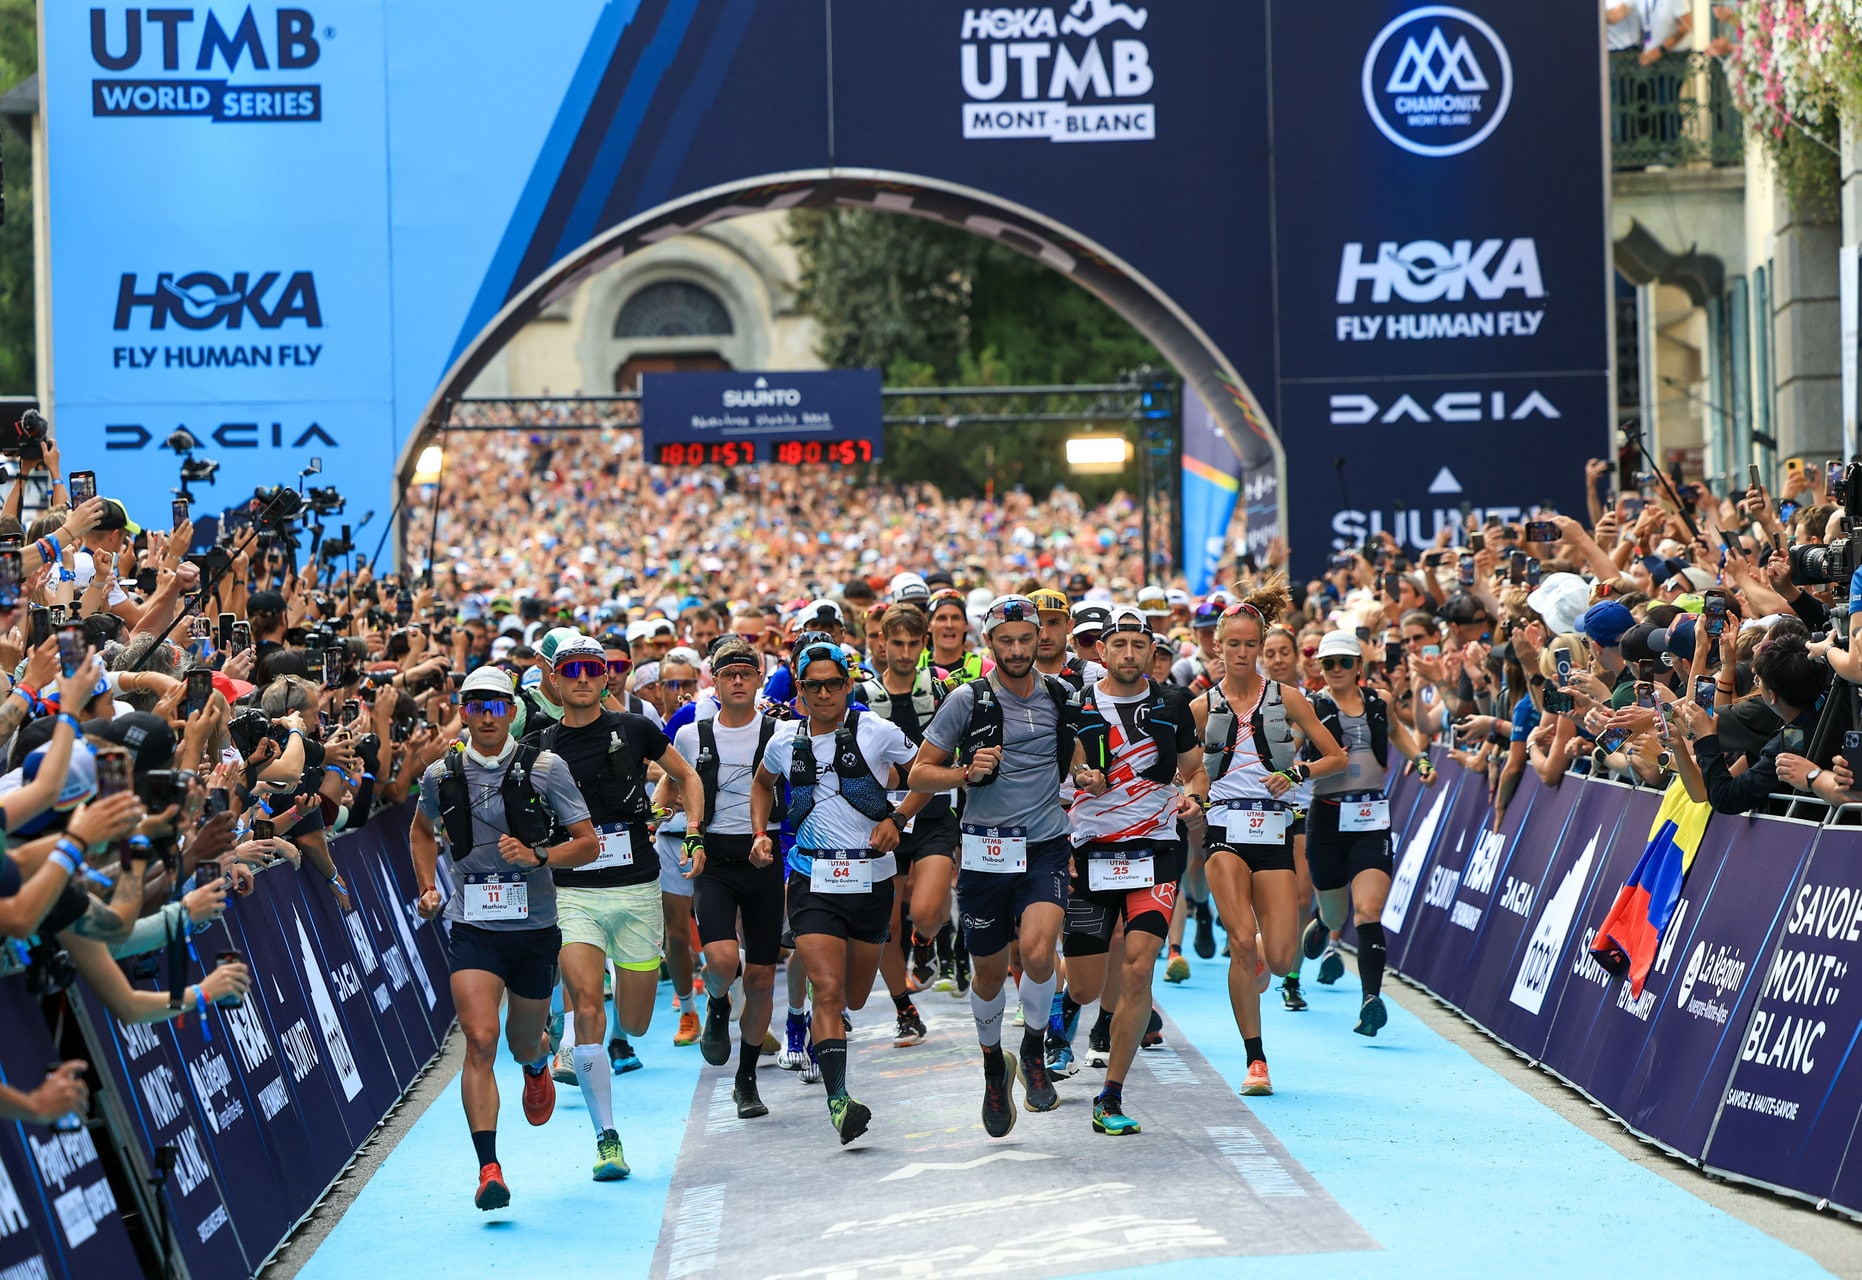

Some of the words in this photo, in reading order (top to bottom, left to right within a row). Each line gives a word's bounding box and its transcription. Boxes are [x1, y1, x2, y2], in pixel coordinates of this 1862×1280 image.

[90, 4, 321, 72] UTMB
[961, 7, 1058, 39] HOKA
[960, 38, 1154, 101] UTMB
[101, 85, 210, 111] WORLD
[223, 90, 315, 117] SERIES
[1395, 94, 1481, 114] CHAMONIX
[1336, 238, 1546, 304] HOKA
[113, 271, 323, 330] HOKA
[1337, 315, 1384, 341] FLY
[1387, 312, 1494, 339] HUMAN
[1499, 311, 1545, 337] FLY
[114, 346, 157, 369] FLY
[165, 344, 273, 369] HUMAN
[279, 344, 323, 368] FLY
[722, 388, 801, 408] SUUNTO
[1330, 390, 1561, 424] DACIA
[1332, 506, 1560, 552] SUUNT
[1250, 818, 1264, 828] 37
[1359, 809, 1371, 817] 46
[987, 845, 1001, 856] 10
[833, 867, 850, 878] 64
[1113, 867, 1129, 875] 25
[488, 892, 500, 902] 11
[1788, 884, 1862, 942] SAVOIE
[1698, 942, 1716, 982] La
[1709, 945, 1746, 998] Région
[1764, 949, 1837, 1006] MONT
[1742, 1010, 1826, 1075] BLANC
[1726, 1088, 1750, 1110] SAVOIE
[1753, 1094, 1800, 1121] HAUTE-SAVOIE
